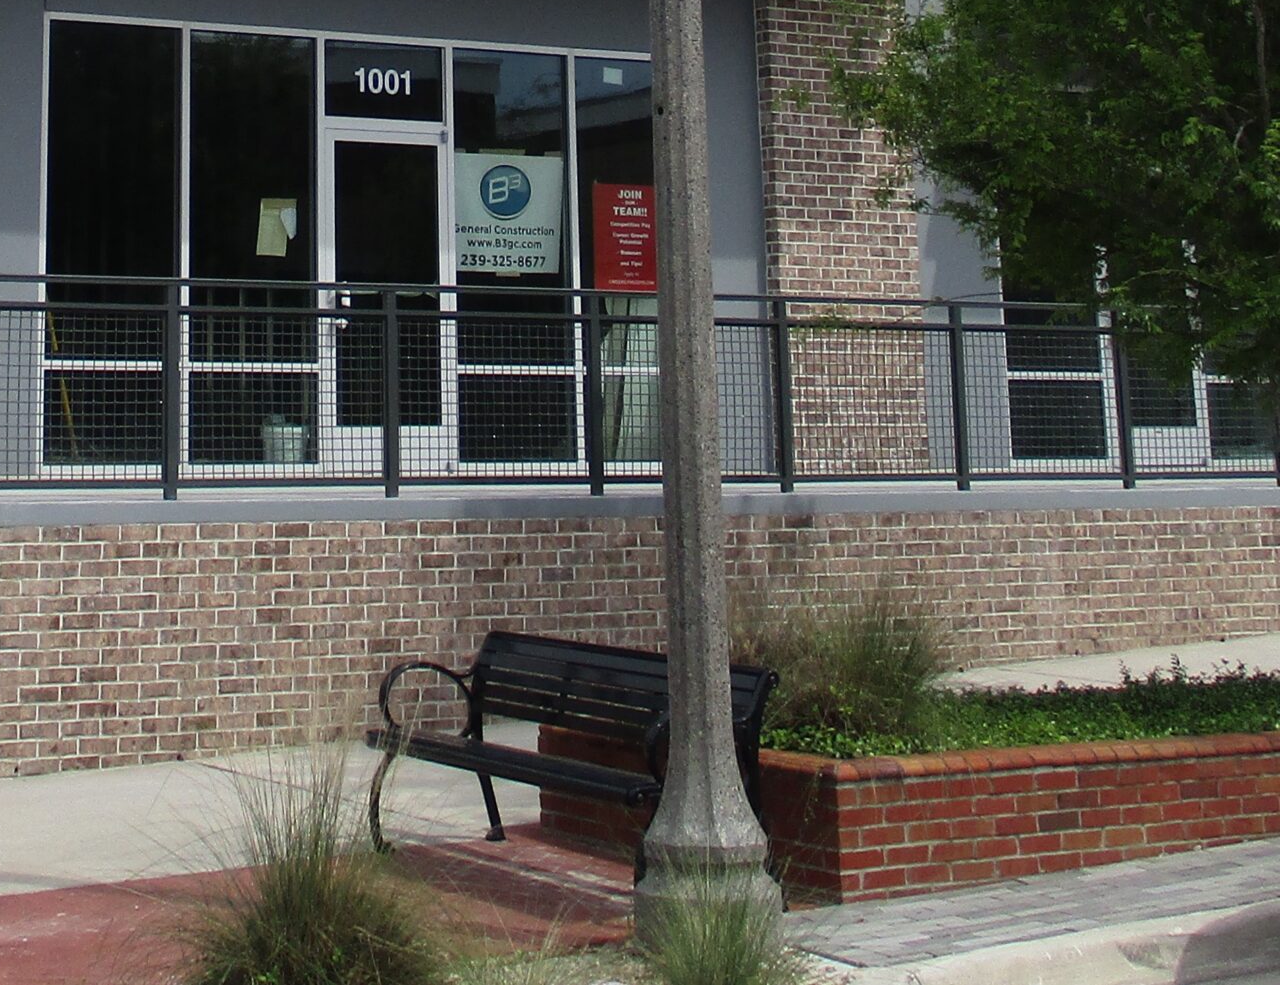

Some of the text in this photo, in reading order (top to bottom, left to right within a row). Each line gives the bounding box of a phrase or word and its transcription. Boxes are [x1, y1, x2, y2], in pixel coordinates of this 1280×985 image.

[354, 67, 411, 95] 1001
[617, 190, 642, 200] JOIN
[613, 206, 648, 217] TEAM!!
[494, 225, 555, 236] Construction
[467, 238, 542, 250] www.B3gc.com
[460, 254, 546, 268] 239-325-8677
